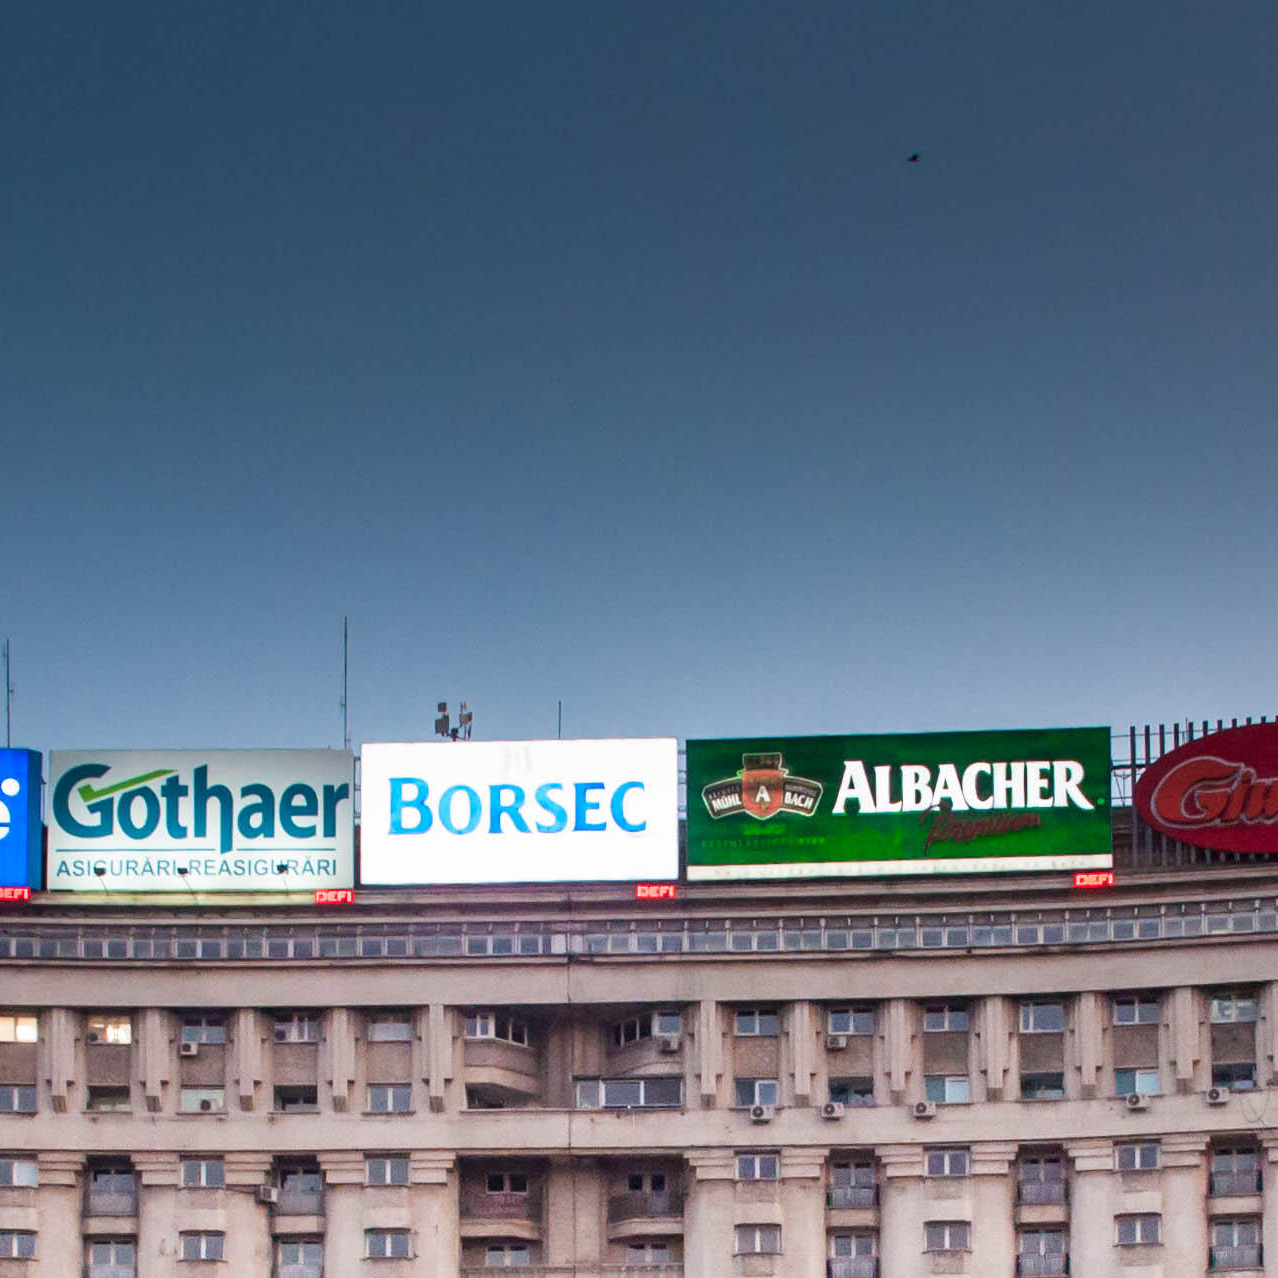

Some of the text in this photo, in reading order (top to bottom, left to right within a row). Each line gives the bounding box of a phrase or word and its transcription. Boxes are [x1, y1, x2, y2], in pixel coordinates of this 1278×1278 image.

[832, 759, 1096, 816] ALBACHER
[52, 762, 350, 855] Gothaer
[387, 776, 648, 836] BORSEC
[315, 891, 352, 902] DEFI
[637, 886, 674, 897] DEFI
[1075, 872, 1113, 887] DEFI
